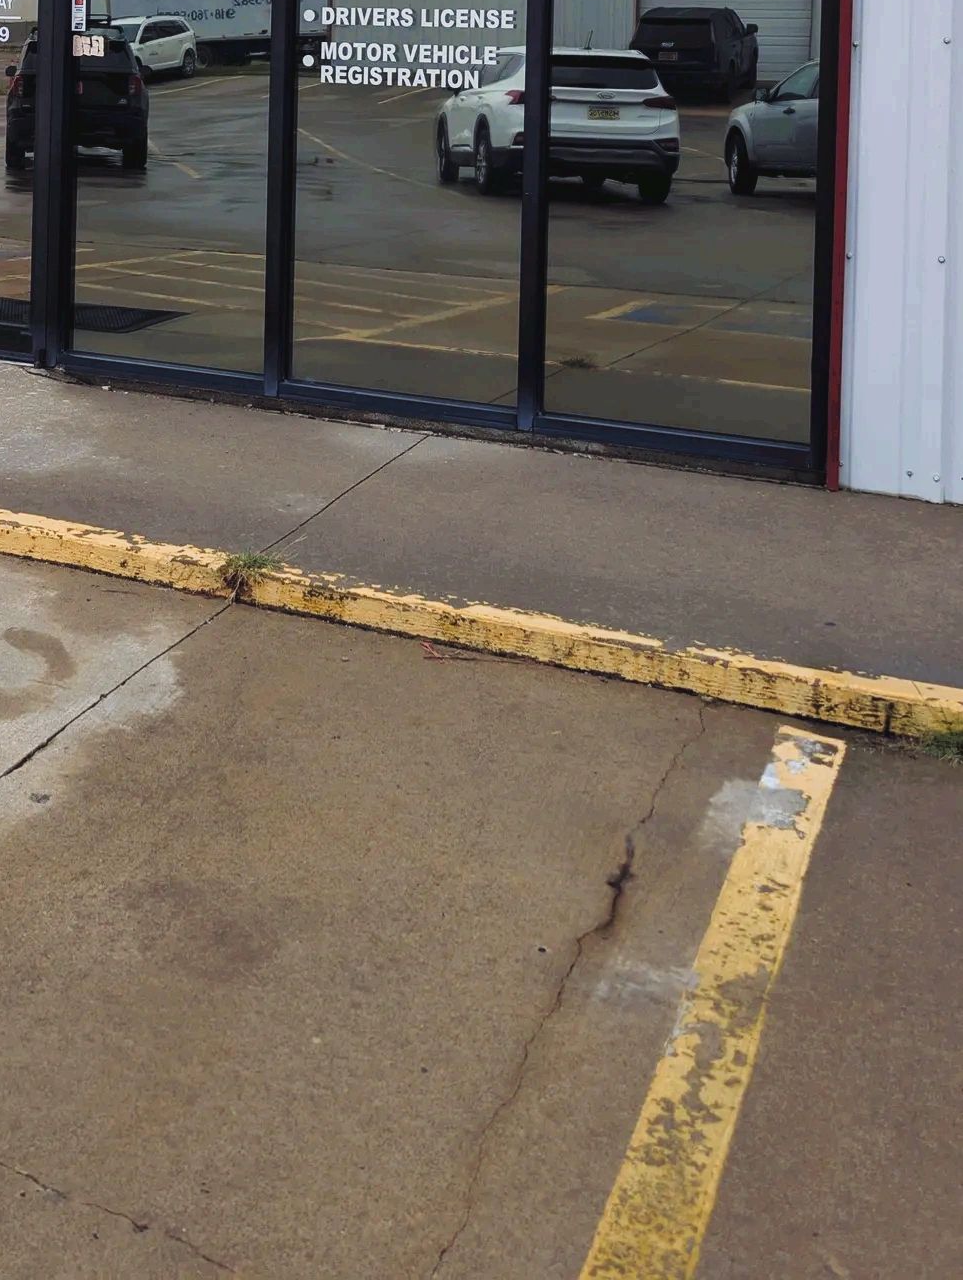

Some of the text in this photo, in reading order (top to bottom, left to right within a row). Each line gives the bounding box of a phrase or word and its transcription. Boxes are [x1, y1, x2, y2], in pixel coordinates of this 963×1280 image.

[321, 7, 515, 29] DRIVERS LICENSE
[320, 41, 498, 66] MOTOR VEHICLE
[320, 65, 480, 89] REGISTRATION
